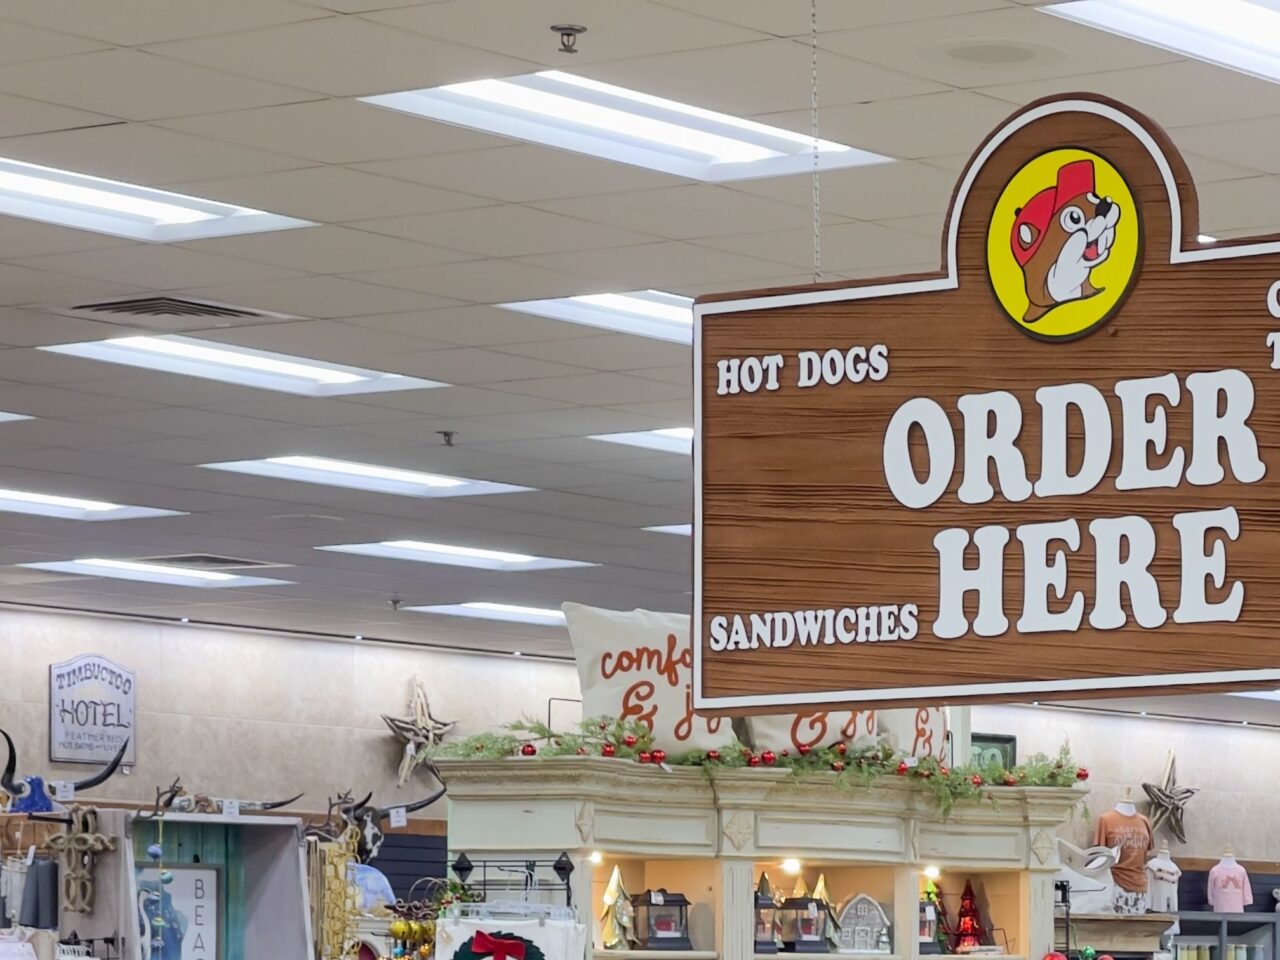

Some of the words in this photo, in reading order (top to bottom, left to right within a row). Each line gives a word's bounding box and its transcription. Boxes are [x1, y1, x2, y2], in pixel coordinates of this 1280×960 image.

[717, 354, 784, 395] HOT
[797, 344, 889, 388] DOGS
[883, 369, 1267, 509] ORDER
[932, 506, 1245, 639] HERE
[709, 603, 919, 651] SANDWICHES
[56, 662, 132, 695] TIMBUCTOO
[600, 633, 691, 686] comfo
[60, 699, 130, 729] HOTEL
